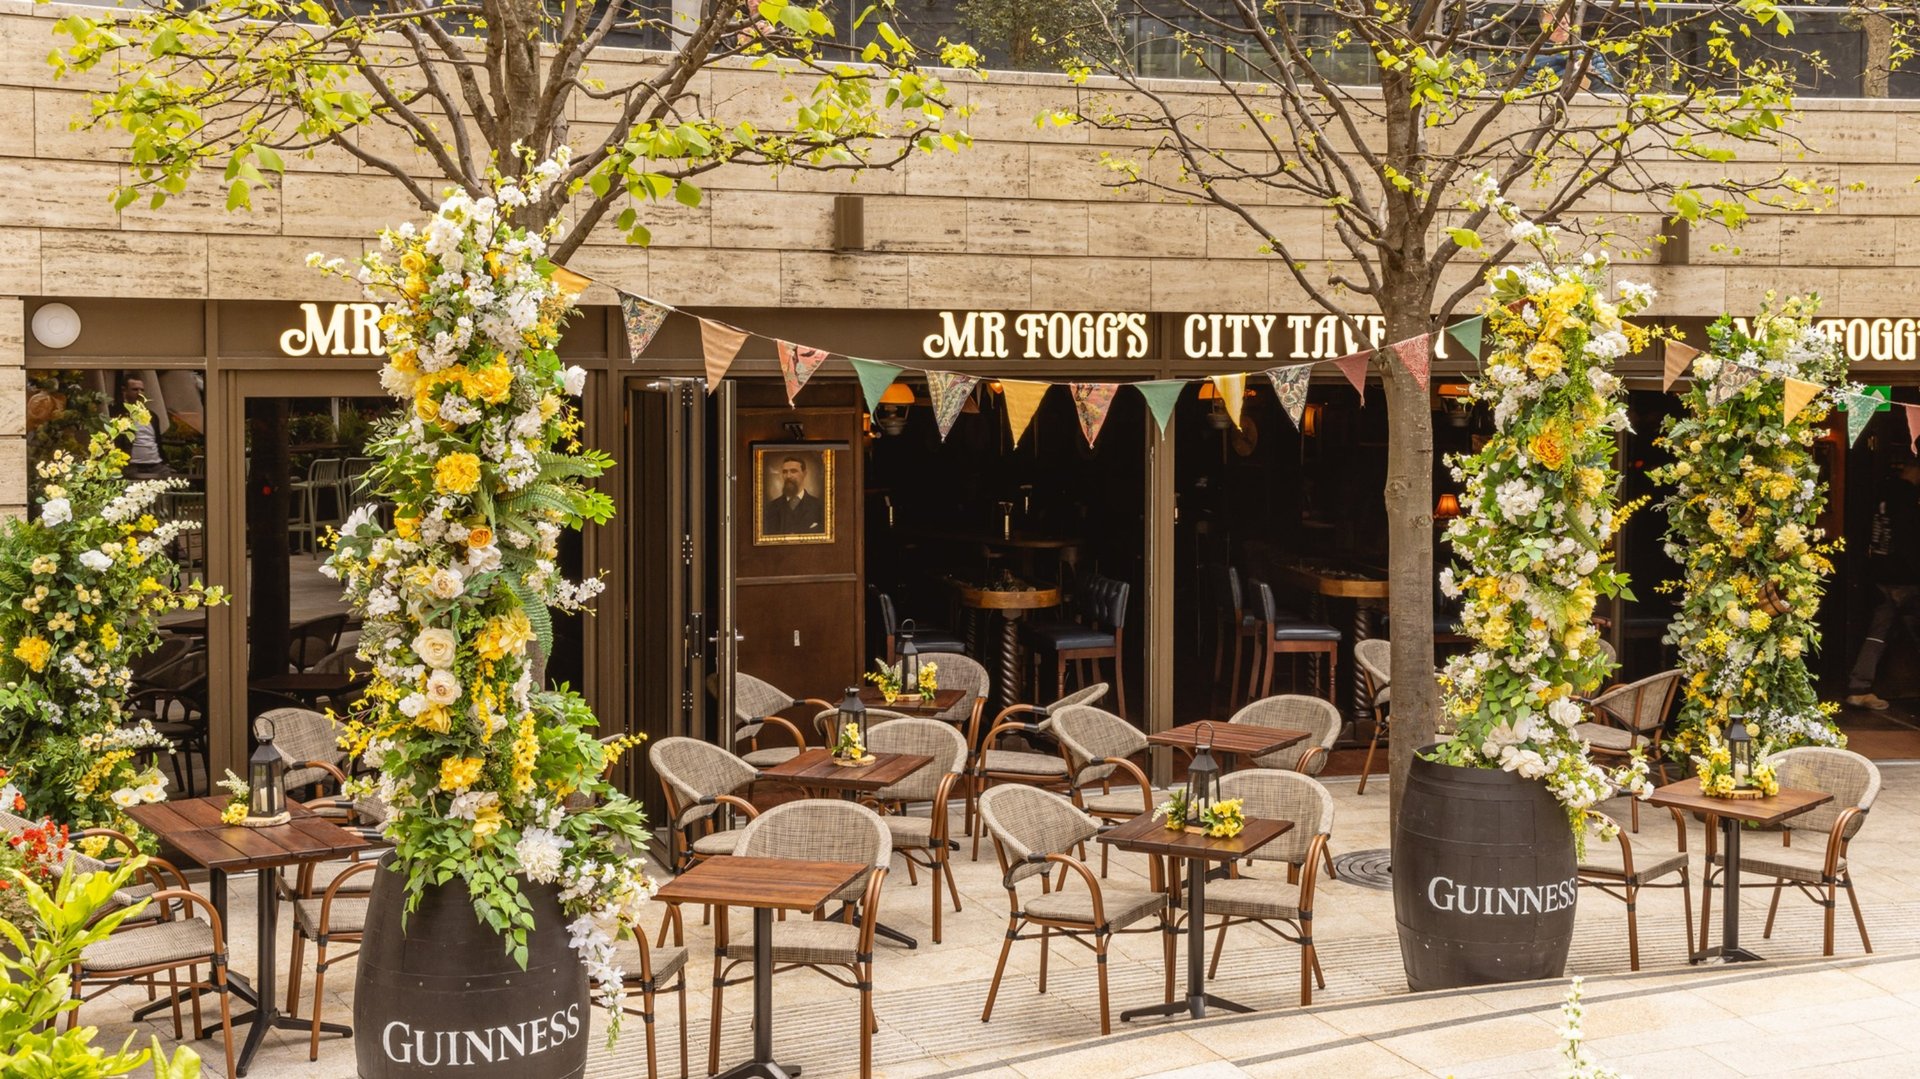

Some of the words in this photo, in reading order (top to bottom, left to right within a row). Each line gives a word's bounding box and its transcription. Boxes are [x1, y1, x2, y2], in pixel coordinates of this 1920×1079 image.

[280, 303, 387, 356] MR
[922, 311, 1009, 359] MR
[1015, 311, 1149, 359] FOGG'S
[1183, 313, 1277, 359] CITY
[1428, 876, 1576, 915] GUINNESS
[382, 1003, 580, 1066] GUINNESS
